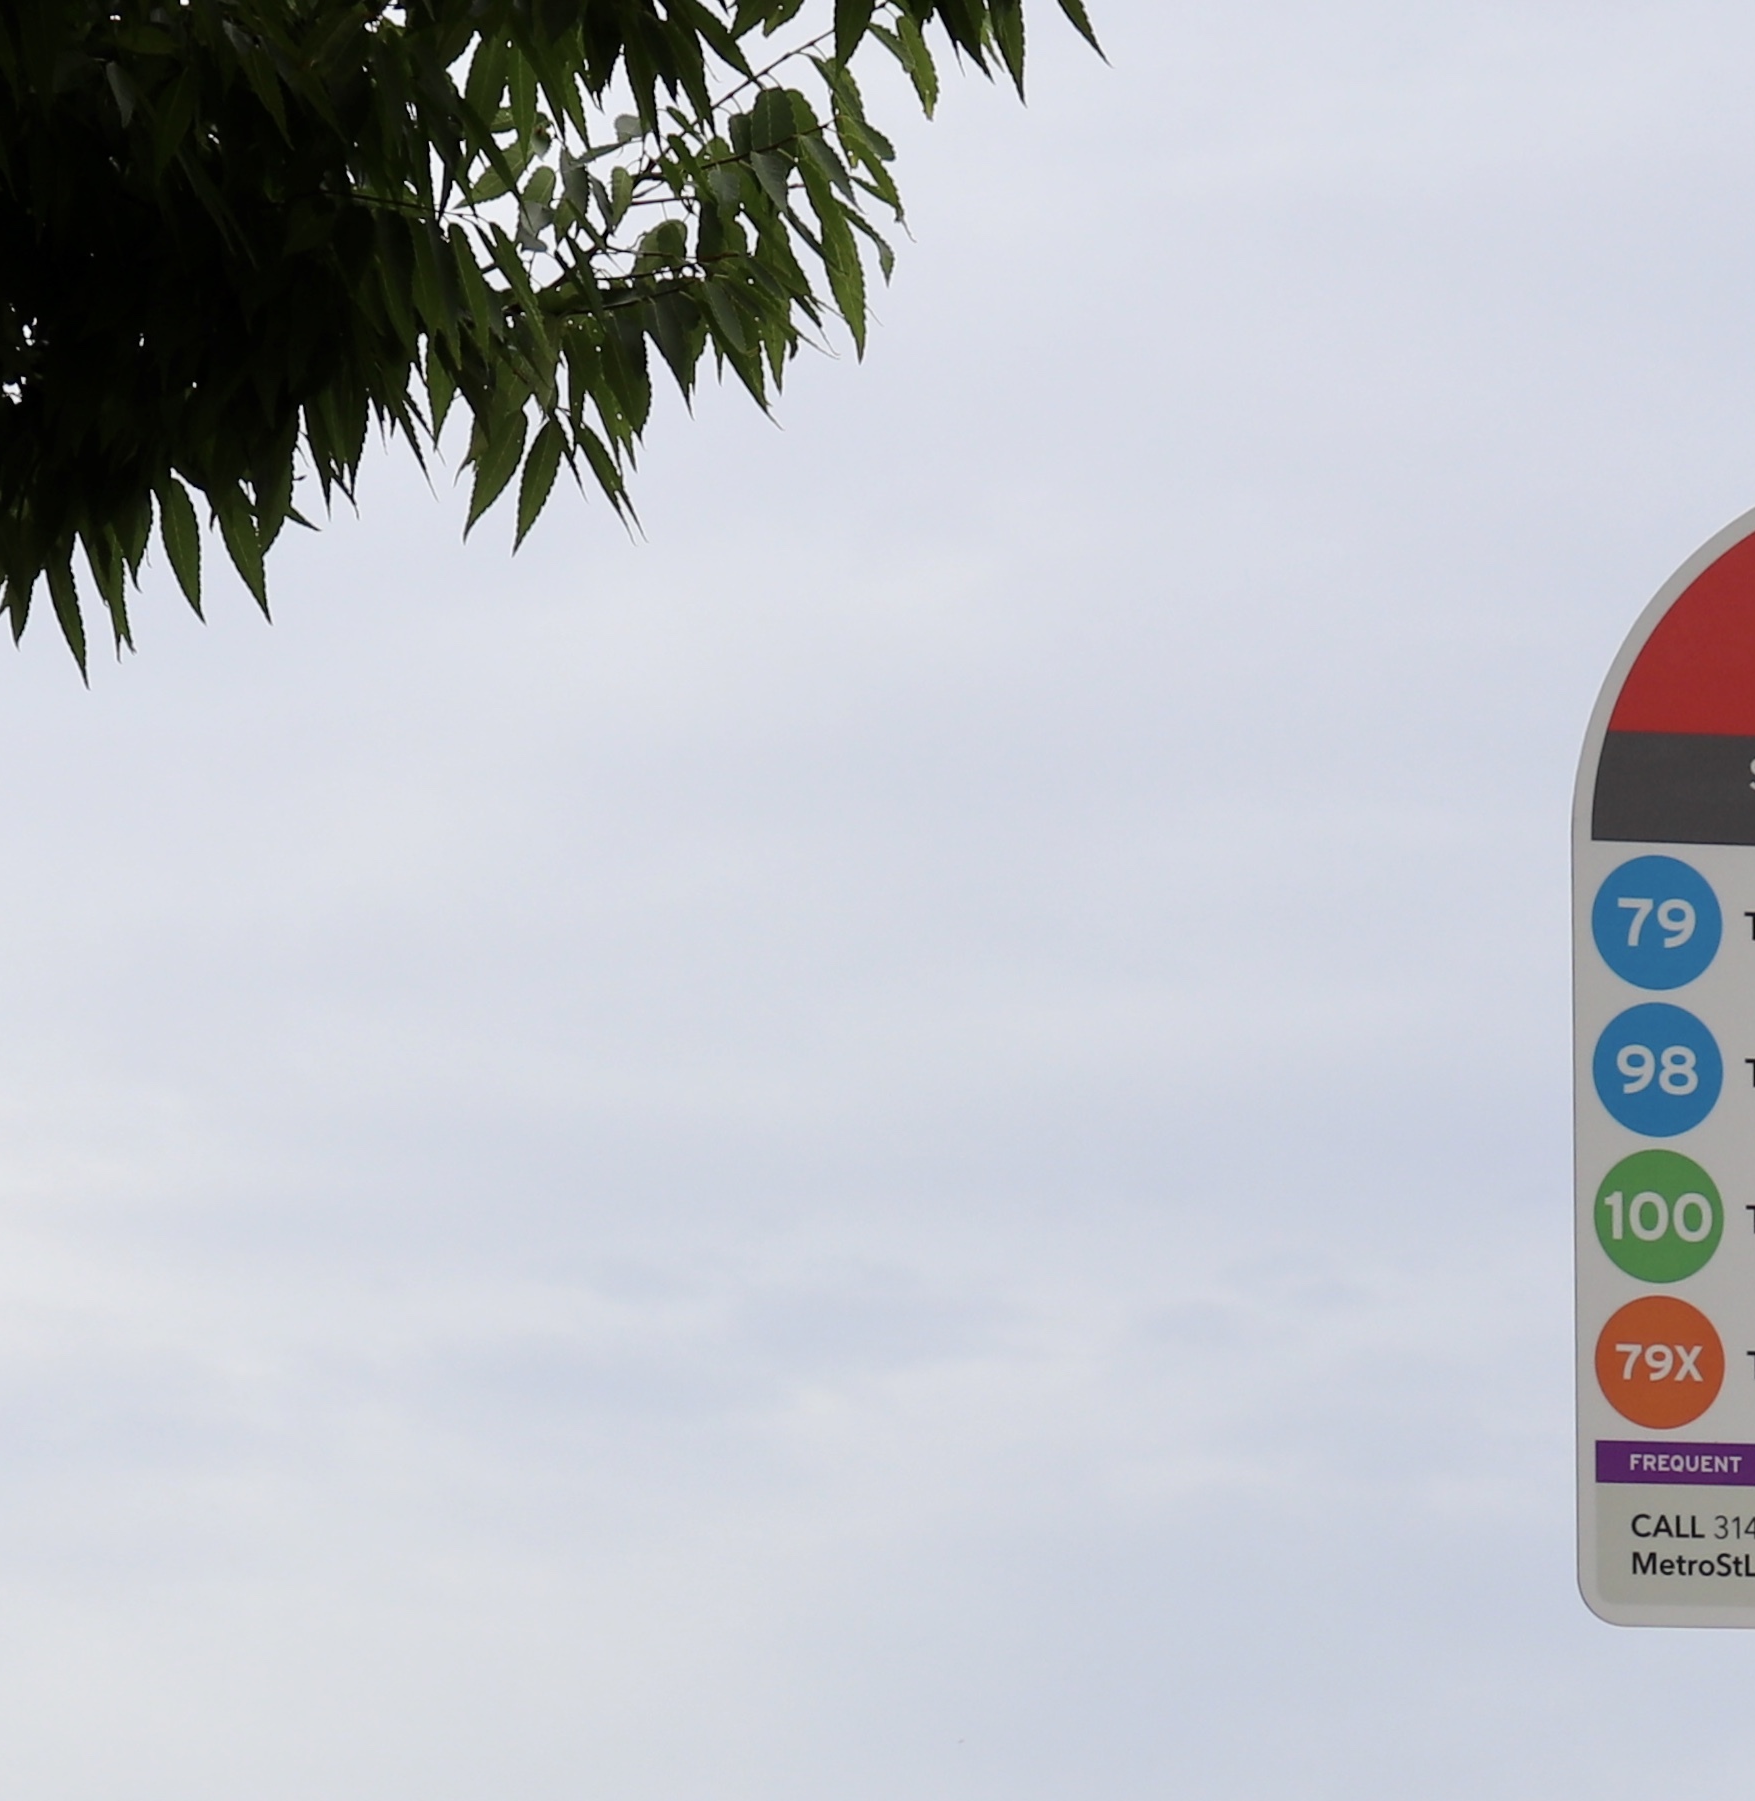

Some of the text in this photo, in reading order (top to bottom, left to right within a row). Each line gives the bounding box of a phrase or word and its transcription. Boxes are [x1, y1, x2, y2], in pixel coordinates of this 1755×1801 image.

[1617, 897, 1696, 949] 79
[1616, 1044, 1699, 1096] 98
[1604, 1191, 1713, 1243] 100
[1615, 1343, 1703, 1382] 79X
[1629, 1453, 1743, 1473] FREQUENT
[1631, 1513, 1706, 1539] CALL
